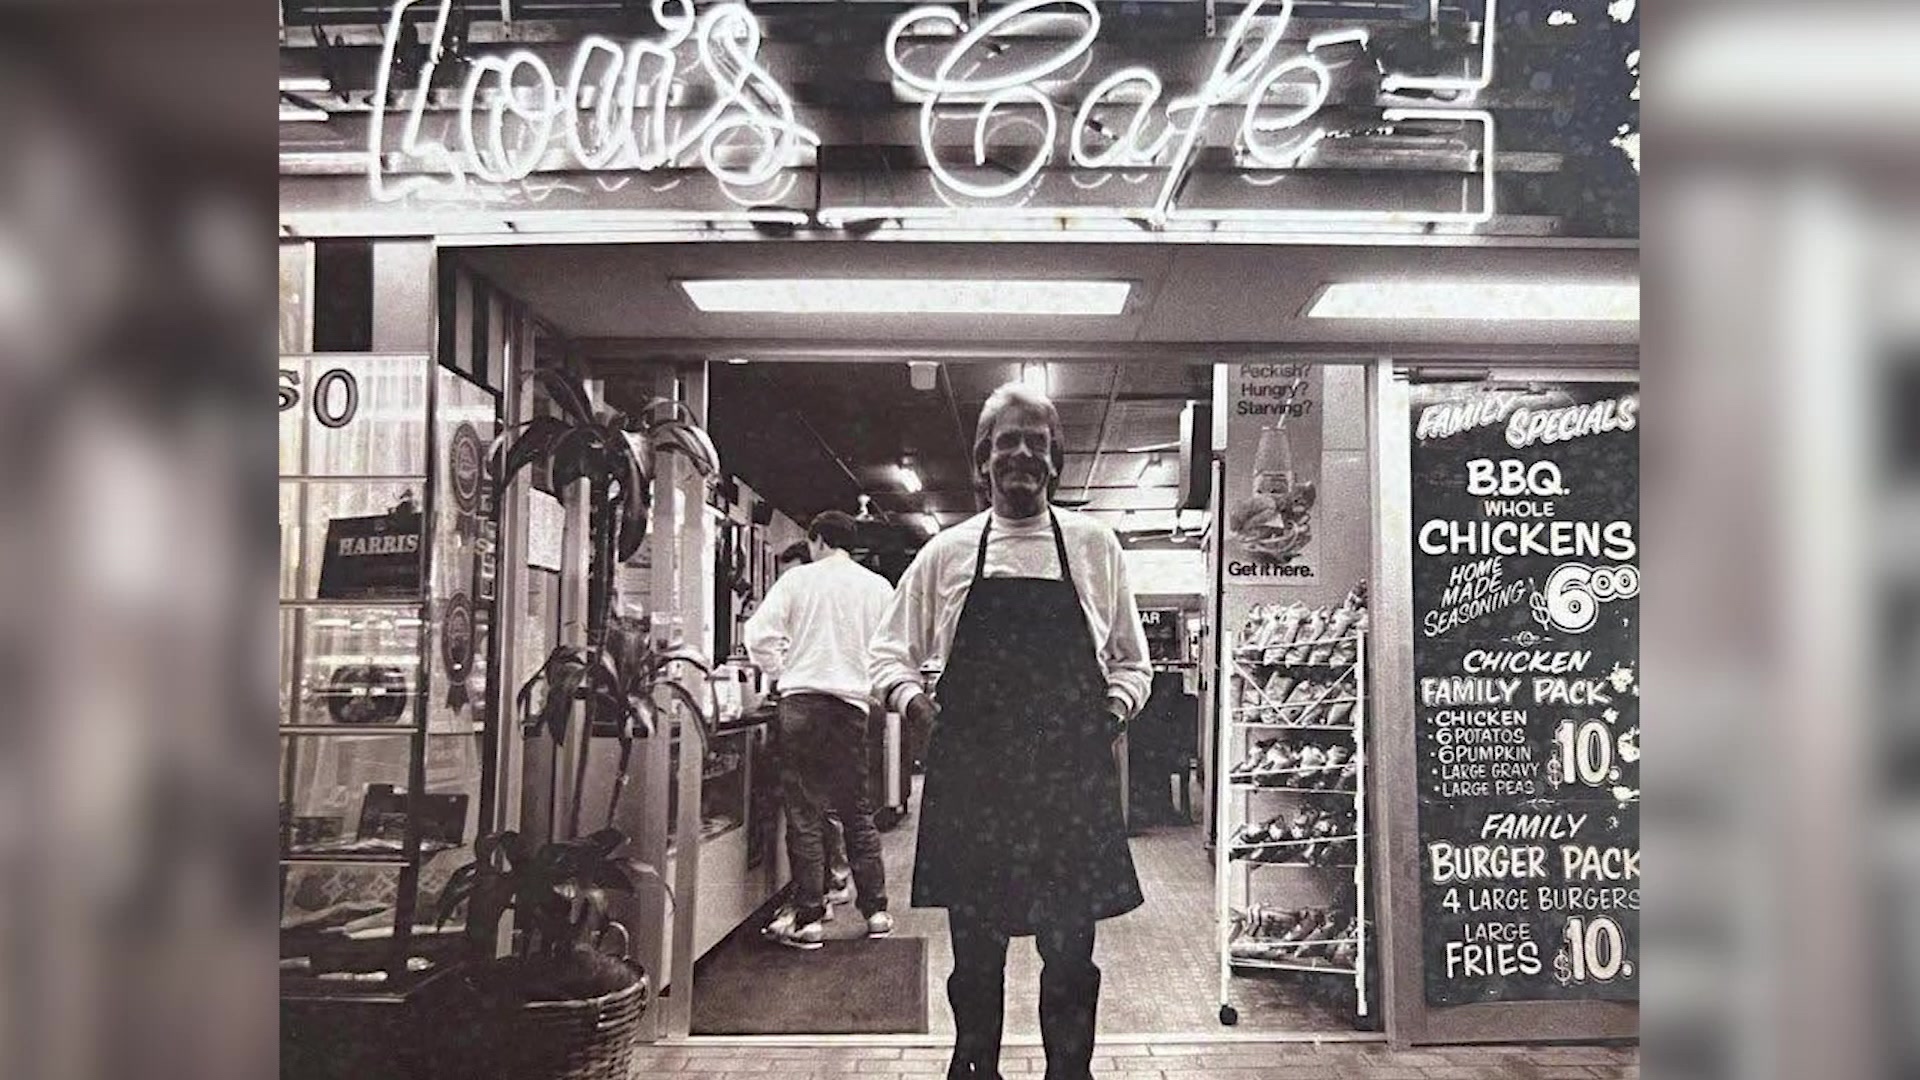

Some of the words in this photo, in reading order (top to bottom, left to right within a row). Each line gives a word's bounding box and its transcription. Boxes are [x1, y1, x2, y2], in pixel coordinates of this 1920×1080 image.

[886, 0, 1369, 228] Café
[1240, 362, 1312, 378] Peckish?
[1241, 381, 1309, 399] Hungry?
[1237, 399, 1313, 417] Starving?
[1416, 397, 1519, 440] FAMILY
[1504, 395, 1637, 449] SPECIALS
[1466, 458, 1571, 497] B.B.Q.
[1484, 500, 1555, 518] WHOLE
[339, 534, 419, 557] HARRIS
[1418, 519, 1637, 560] CHICKENS
[1228, 561, 1257, 576] Get
[1260, 562, 1270, 576] it
[1273, 562, 1315, 577] here.
[1450, 556, 1503, 587] HOME
[1441, 575, 1503, 608] MADE
[1424, 580, 1526, 637] SEASONING
[1462, 650, 1592, 674] CHICKEN
[1421, 676, 1522, 706] FAMILY
[1533, 677, 1613, 705] PACK
[1435, 710, 1528, 727] CHICKEN
[1442, 764, 1486, 780] LARGE
[1491, 762, 1540, 778] GRAVY
[1442, 781, 1489, 797] LARGE
[1495, 780, 1537, 795] PEAS
[1480, 813, 1588, 839] FAMILY
[1429, 842, 1547, 883] BURGER
[1562, 845, 1640, 881] PACK
[1442, 888, 1461, 913] 4
[1469, 888, 1530, 911] LARGE
[1537, 887, 1640, 911] BURGERS
[1464, 922, 1531, 942] LARGE
[1446, 941, 1543, 979] FRIES
